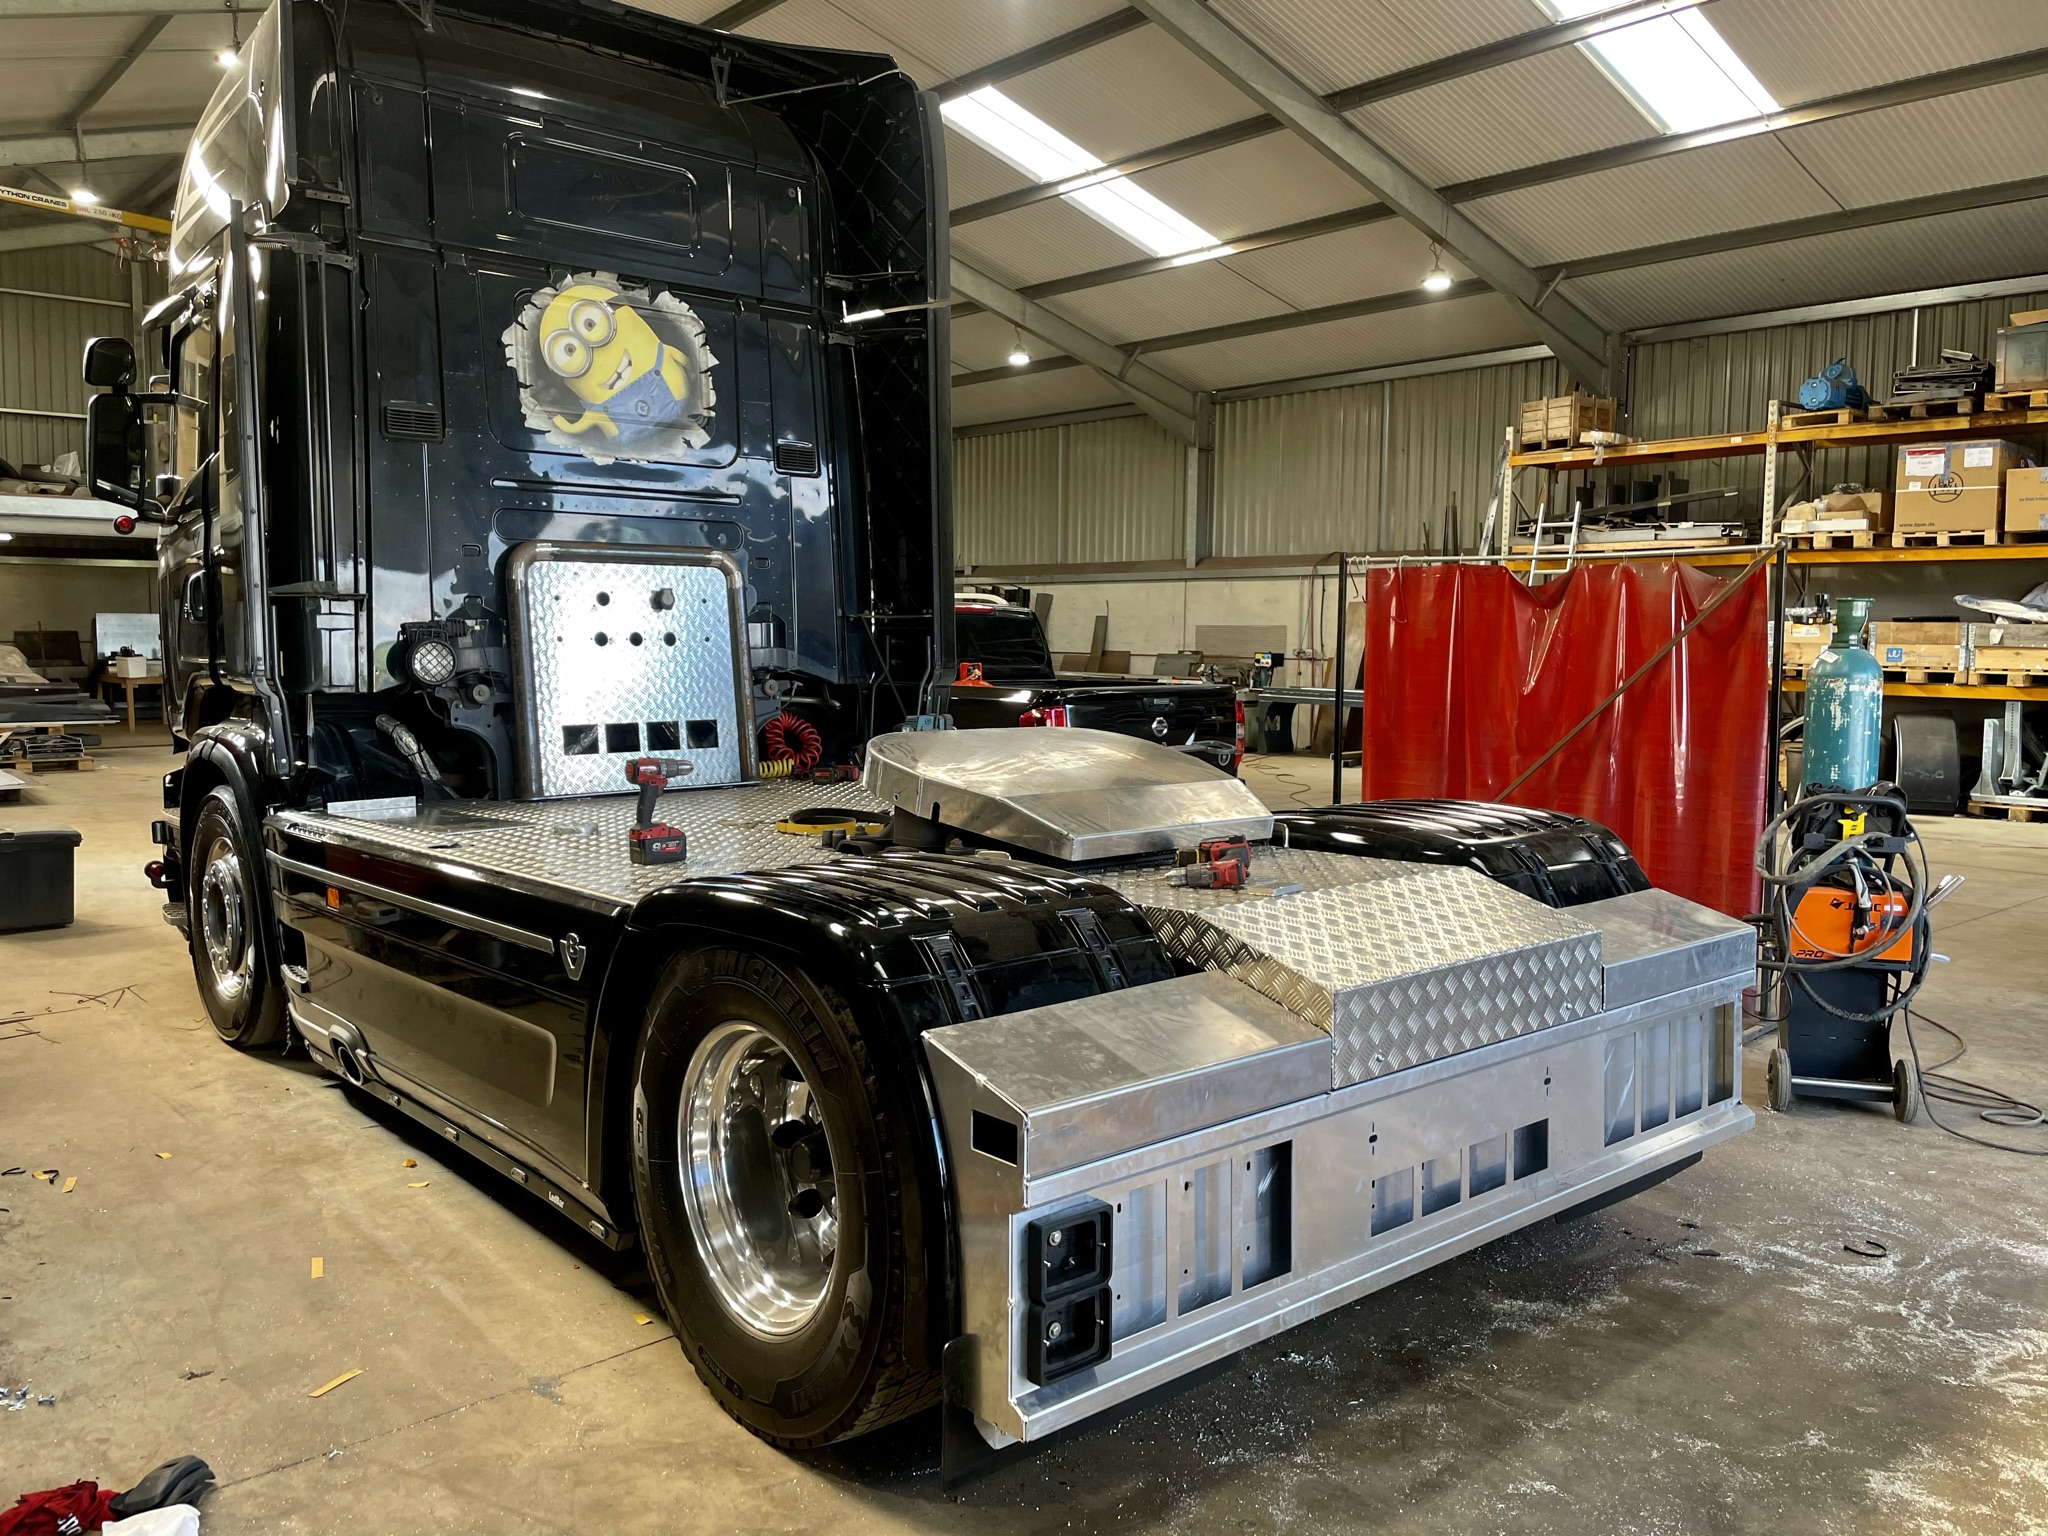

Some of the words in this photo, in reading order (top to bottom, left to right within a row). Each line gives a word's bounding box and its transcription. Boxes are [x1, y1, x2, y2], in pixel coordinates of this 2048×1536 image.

[32, 195, 67, 207] CRANES
[1796, 949, 1824, 958] PRO
[713, 950, 839, 1072] MICHELIN
